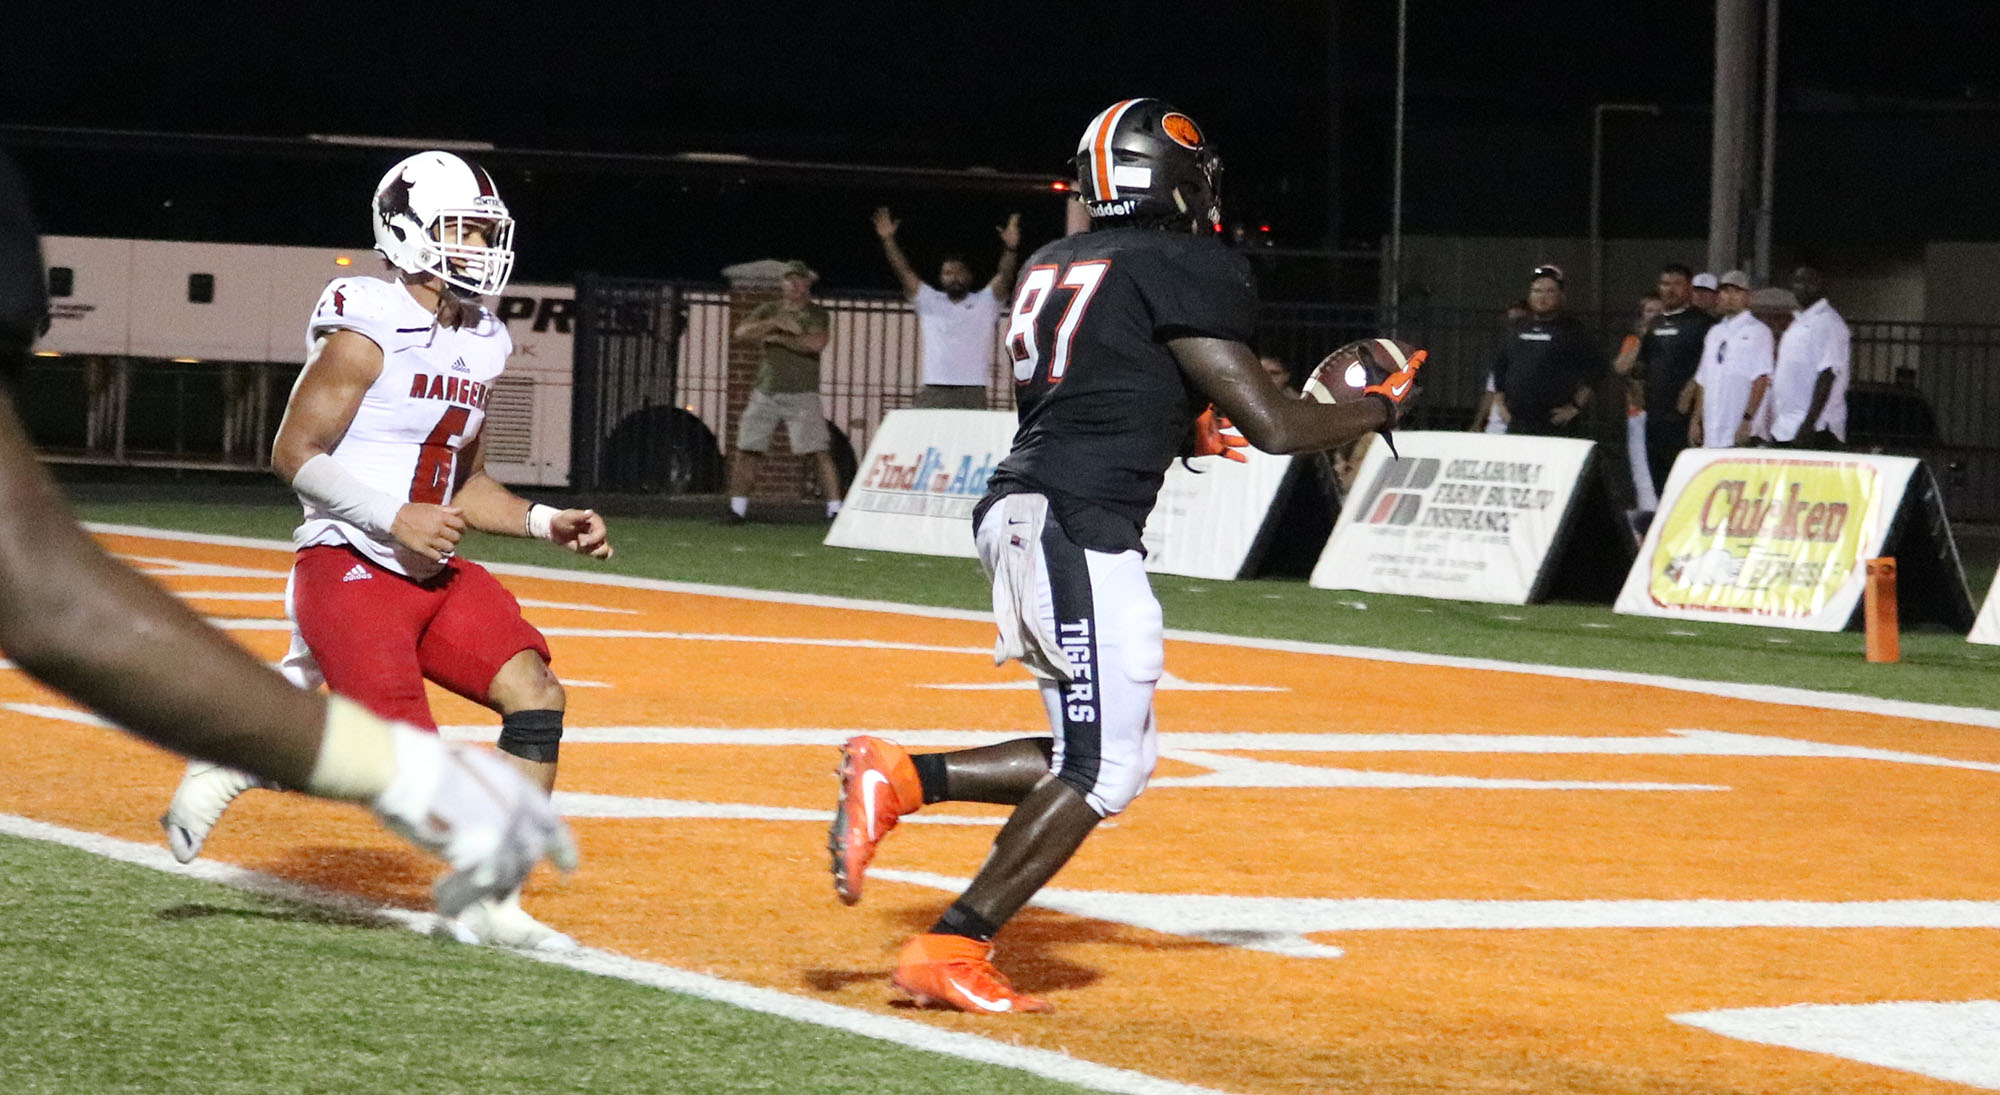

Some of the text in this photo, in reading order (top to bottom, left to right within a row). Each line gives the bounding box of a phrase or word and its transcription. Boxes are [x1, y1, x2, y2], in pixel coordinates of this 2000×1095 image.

[1006, 259, 1112, 386] 87
[408, 404, 472, 506] 6
[946, 452, 999, 496] Ad
[1431, 482, 1485, 507] FARM
[1700, 479, 1848, 543] Chicken
[1059, 618, 1095, 724] TIGERS
